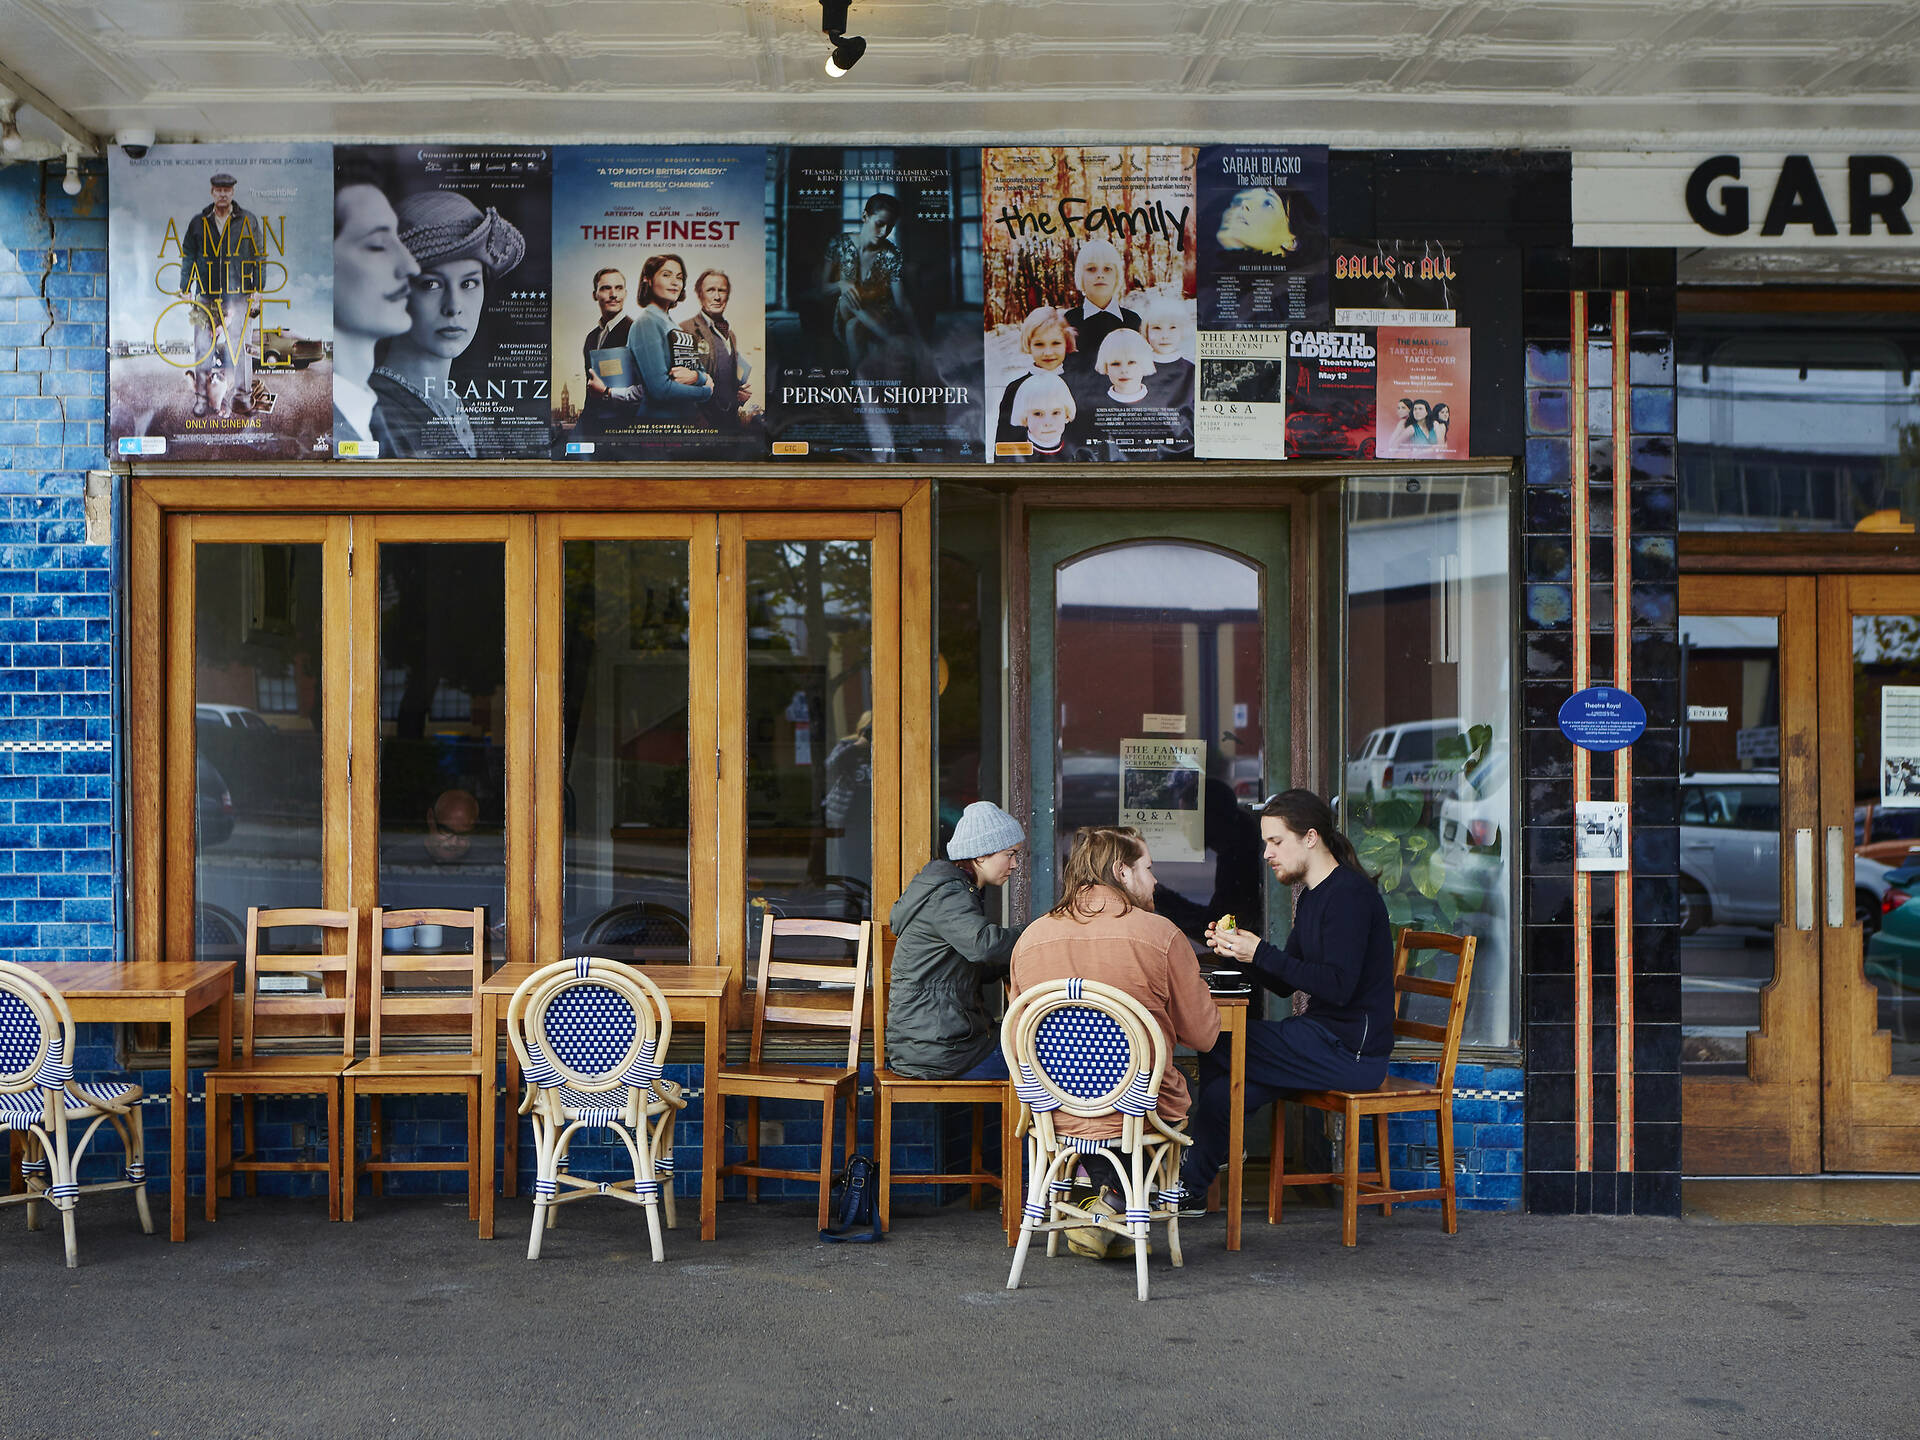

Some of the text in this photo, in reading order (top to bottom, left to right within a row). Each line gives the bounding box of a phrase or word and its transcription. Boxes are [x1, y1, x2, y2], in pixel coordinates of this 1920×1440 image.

[1222, 156, 1301, 174] SARAH BLASKO
[1237, 174, 1288, 186] The Soloist Tour
[1685, 154, 1914, 237] GAR
[580, 220, 740, 240] THEIR FINEST
[995, 204, 1058, 240] the
[1058, 198, 1190, 252] Family
[157, 215, 286, 258] A MAN
[1335, 255, 1396, 280] BALLS
[1420, 256, 1456, 280] ALL
[155, 261, 288, 296] CALLED
[153, 299, 292, 368] OVE
[1200, 333, 1280, 343] THE FAMILY
[1290, 331, 1366, 346] GARETH
[1290, 344, 1376, 359] LIDDIARD
[1411, 348, 1432, 356] CARE
[1353, 360, 1376, 368] Royal
[1426, 356, 1456, 364] COVER
[1318, 372, 1348, 380] May 13
[423, 376, 549, 400] FRANTZ
[782, 386, 969, 404] PERSONAL SHOPPER
[1214, 404, 1224, 415] Q
[1230, 404, 1238, 414] &
[1244, 404, 1253, 414] A
[185, 419, 262, 429] ONLY IN CINEMAS
[1606, 702, 1622, 710] Royal
[1124, 746, 1199, 754] THE FAMILY
[1136, 811, 1146, 821] Q
[1152, 812, 1158, 820] &
[1165, 812, 1172, 820] A
